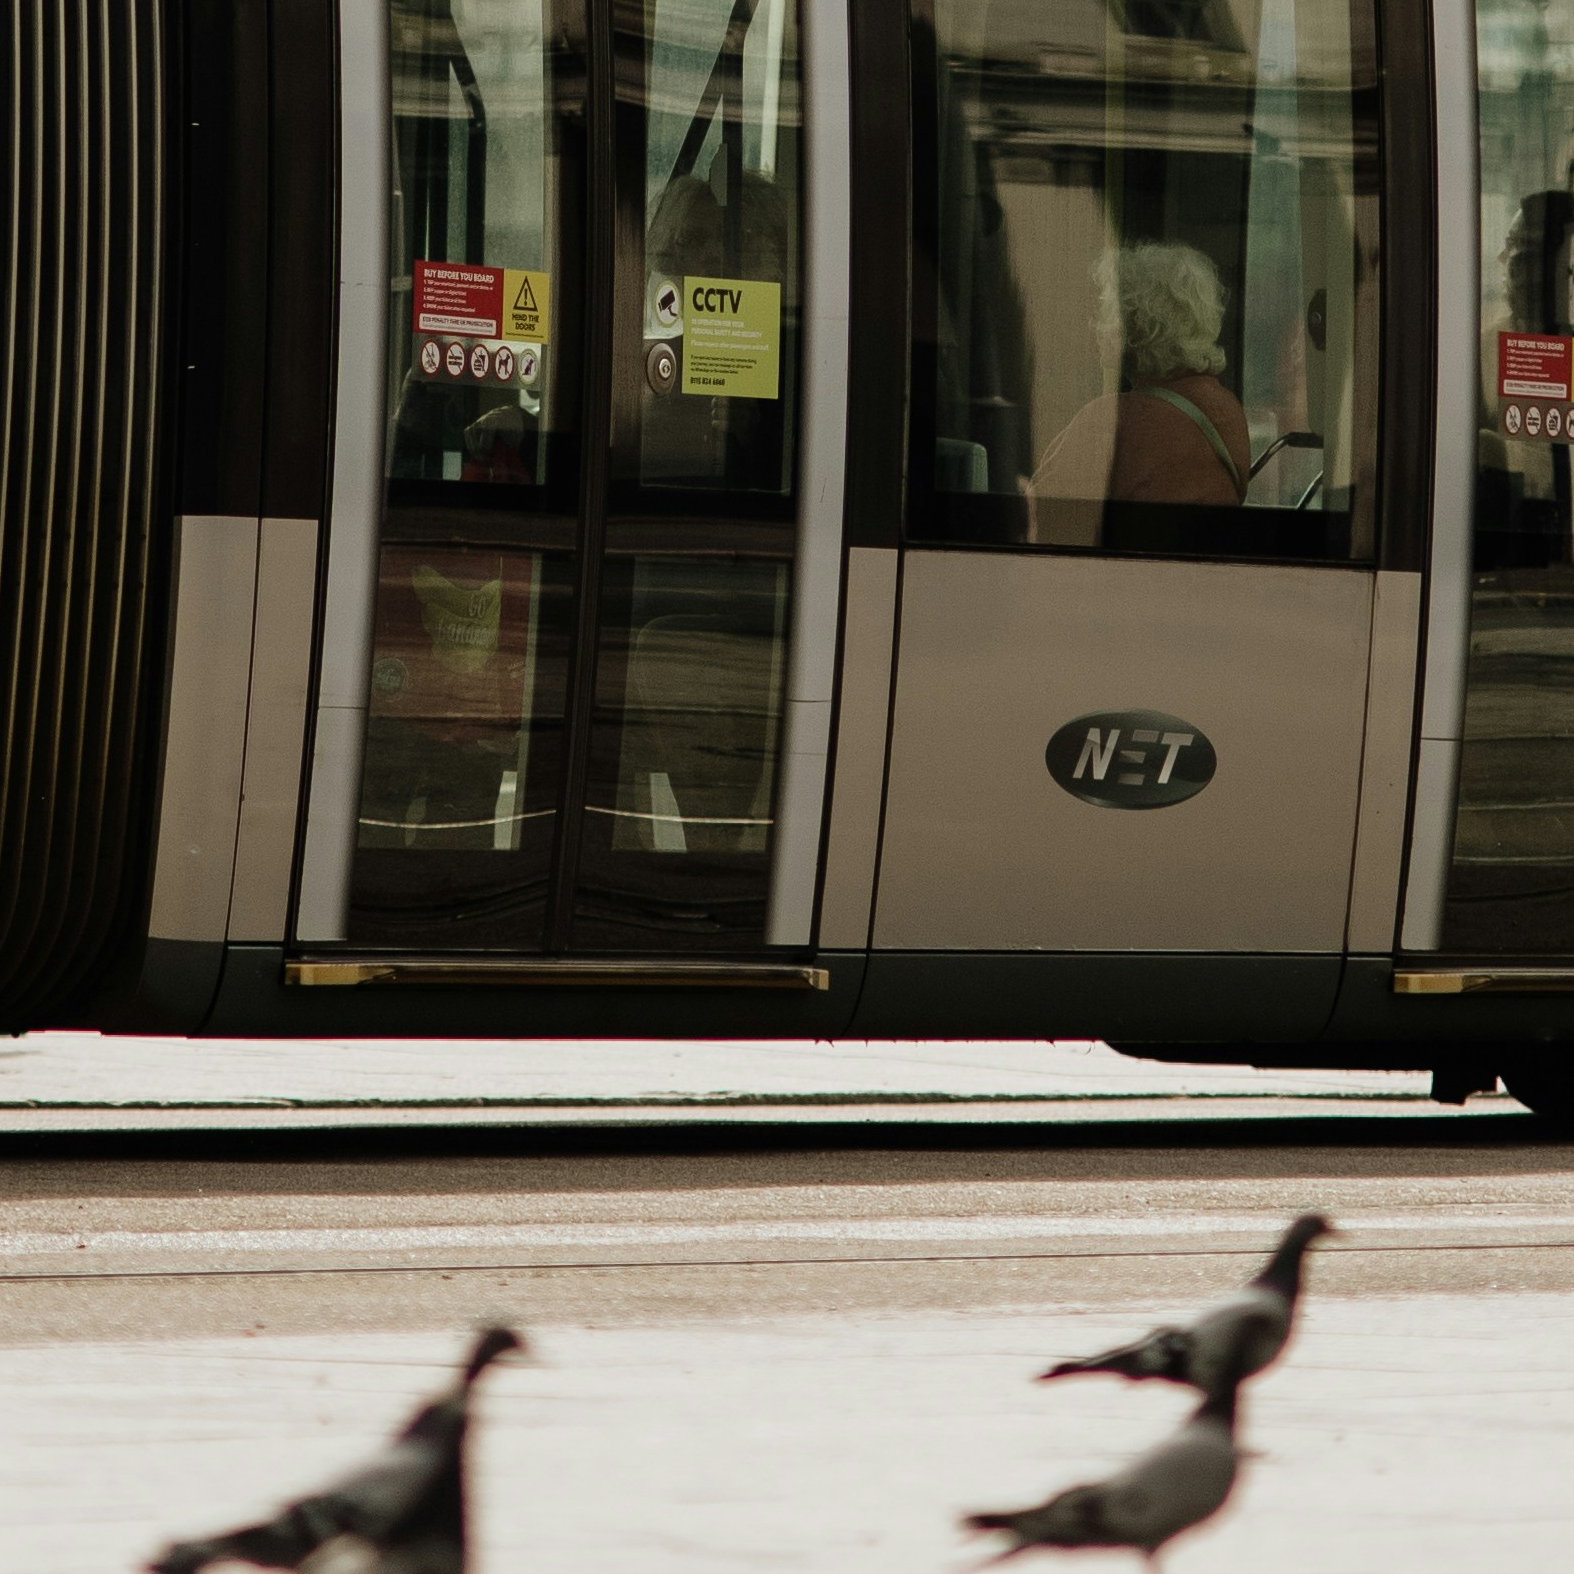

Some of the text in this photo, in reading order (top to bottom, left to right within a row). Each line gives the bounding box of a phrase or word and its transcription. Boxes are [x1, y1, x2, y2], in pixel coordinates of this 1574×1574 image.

[424, 268, 495, 284] BUY BEFORE YOU BOARD
[692, 287, 742, 314] CCTV
[512, 313, 539, 323] MIND THE
[515, 322, 536, 332] DOORS
[1072, 727, 1195, 785] NET
